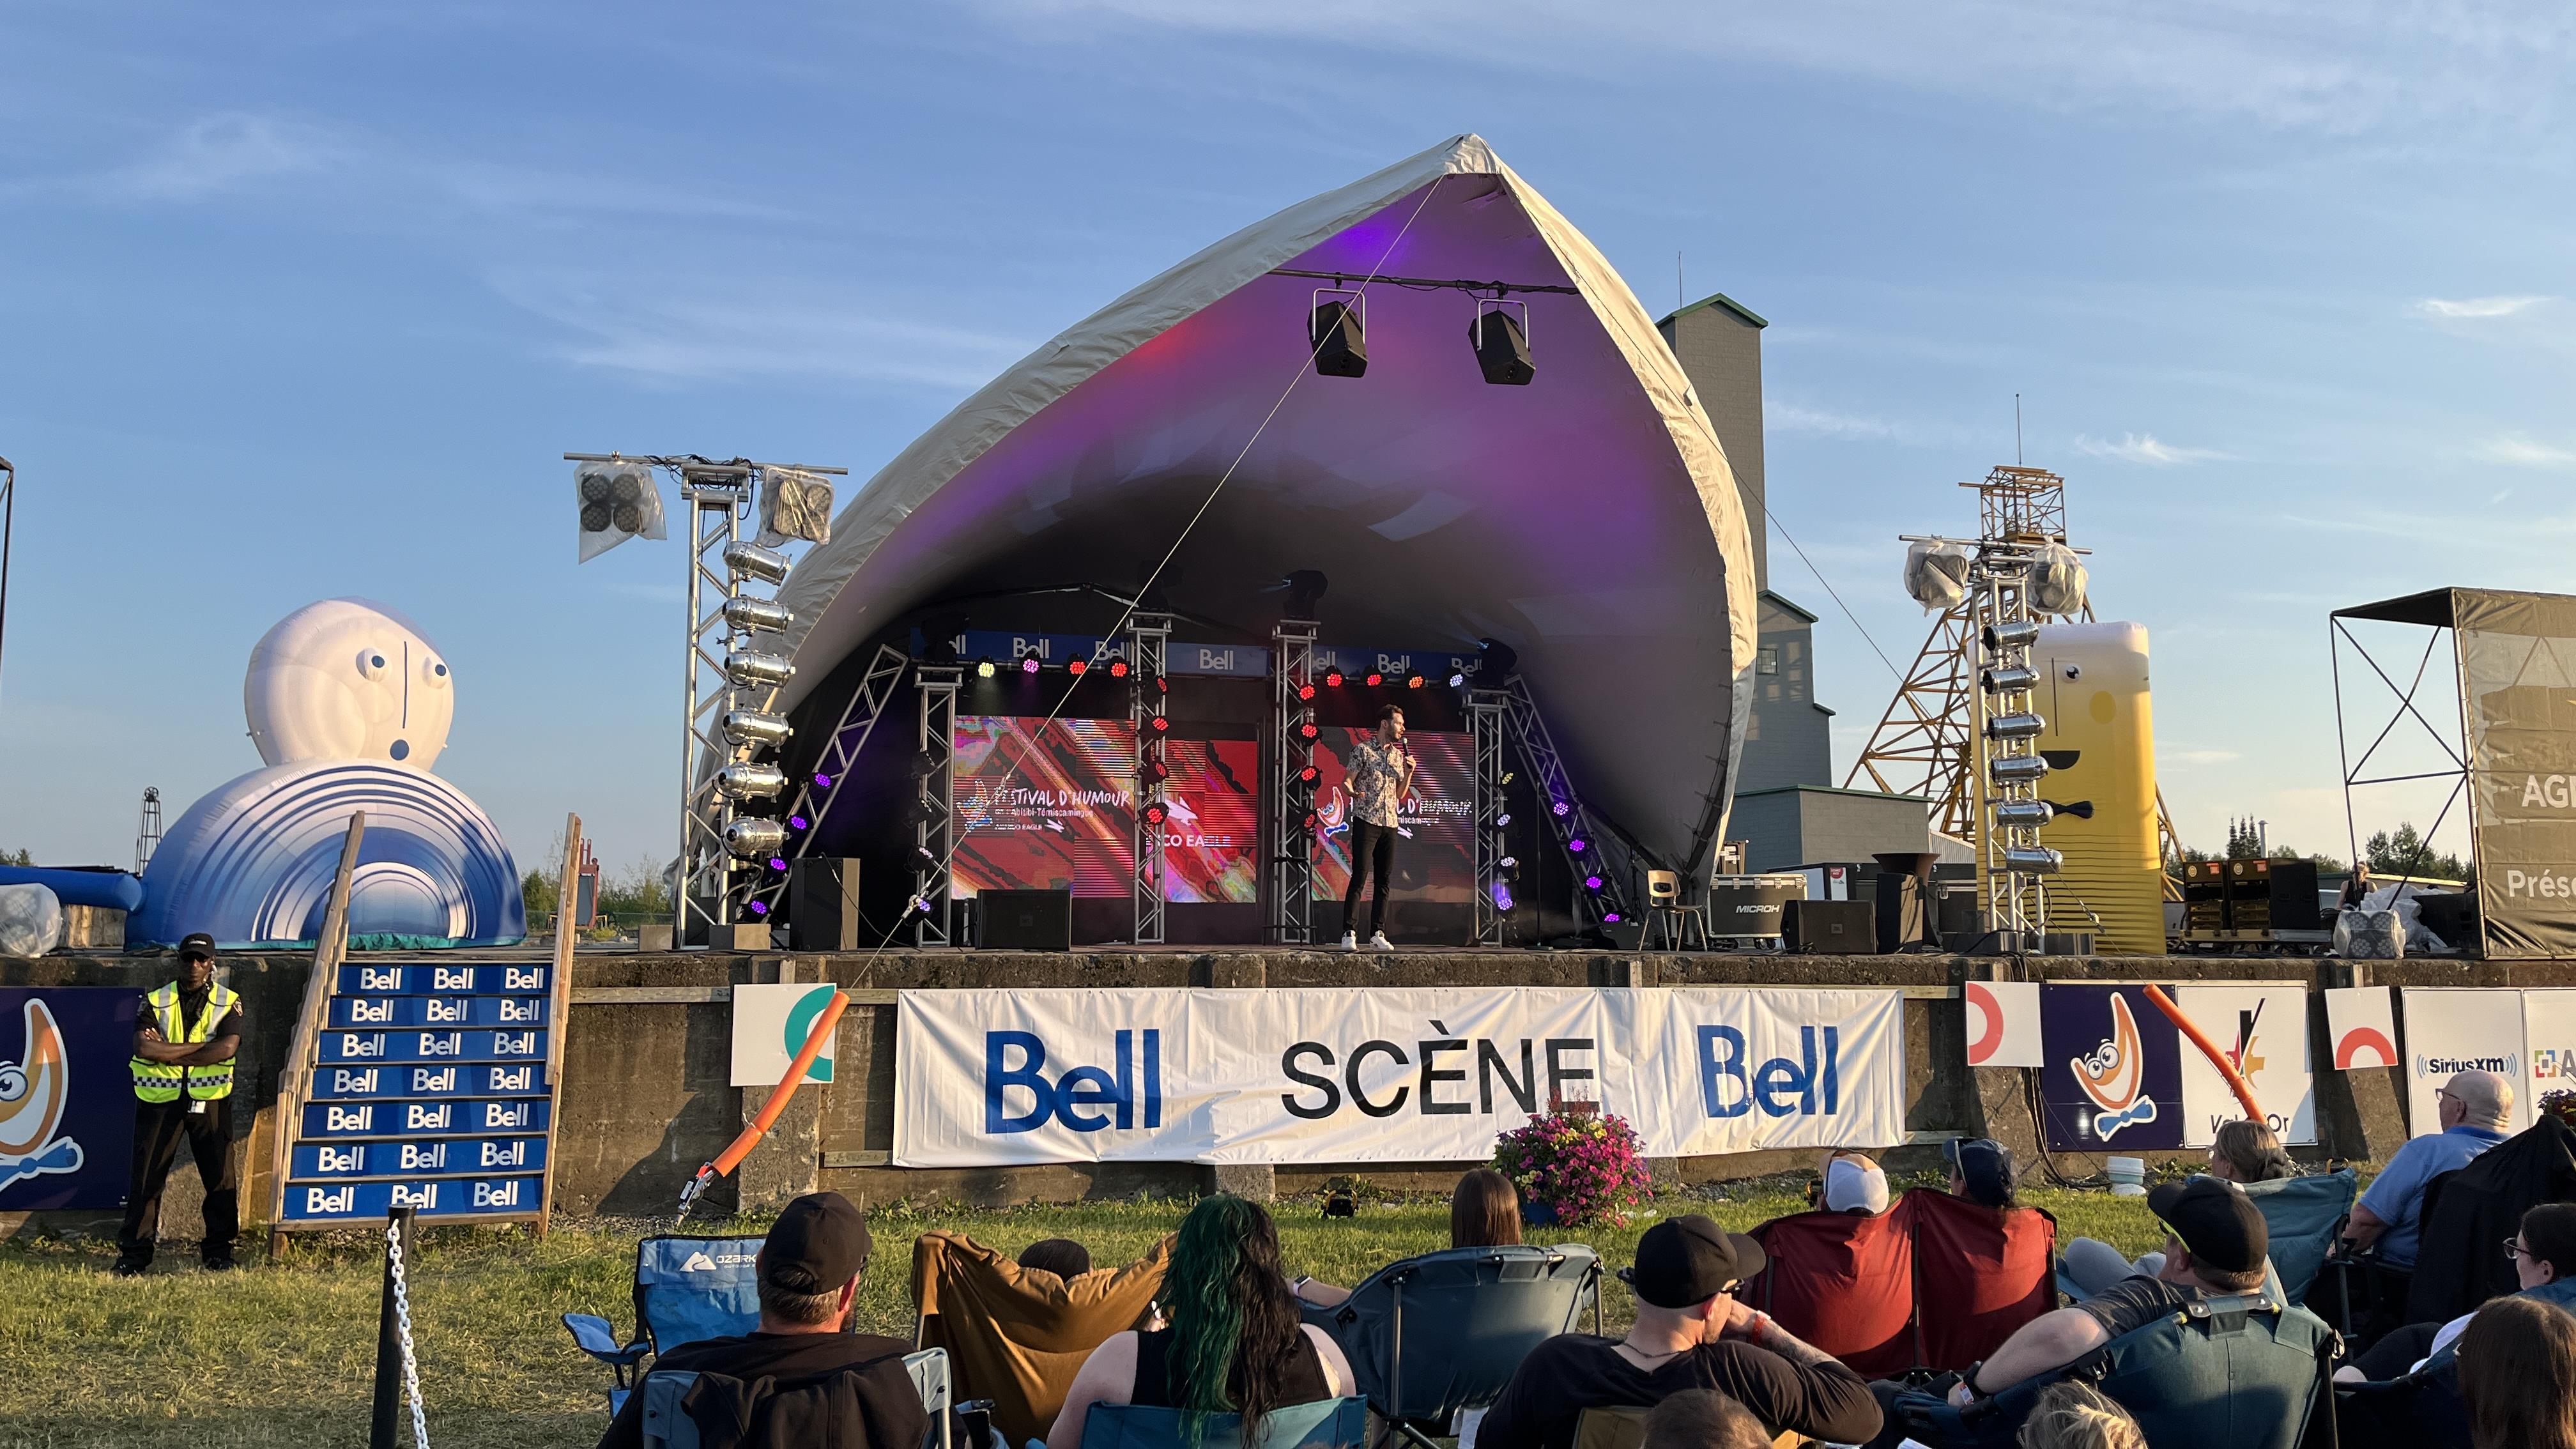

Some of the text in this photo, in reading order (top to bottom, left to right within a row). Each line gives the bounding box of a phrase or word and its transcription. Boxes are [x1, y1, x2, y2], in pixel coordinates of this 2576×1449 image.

[1095, 641, 1130, 661] Bell
[1200, 649, 1234, 670] Bell
[1377, 654, 1410, 674] Bell
[1736, 905, 1780, 913] MICROH
[360, 967, 544, 990] Bell Bell Bell
[352, 999, 539, 1022] Bell Bell Bell
[342, 1032, 535, 1057] Bell Bell Bell
[334, 1067, 530, 1092] Bell Bell Bell
[985, 1020, 1839, 1134] Bell SCÈNE Bell
[327, 1103, 528, 1131] Bell Bell Bell
[318, 1142, 525, 1172] Bell Bell Bell
[307, 1181, 518, 1213] Bell Bell Bell
